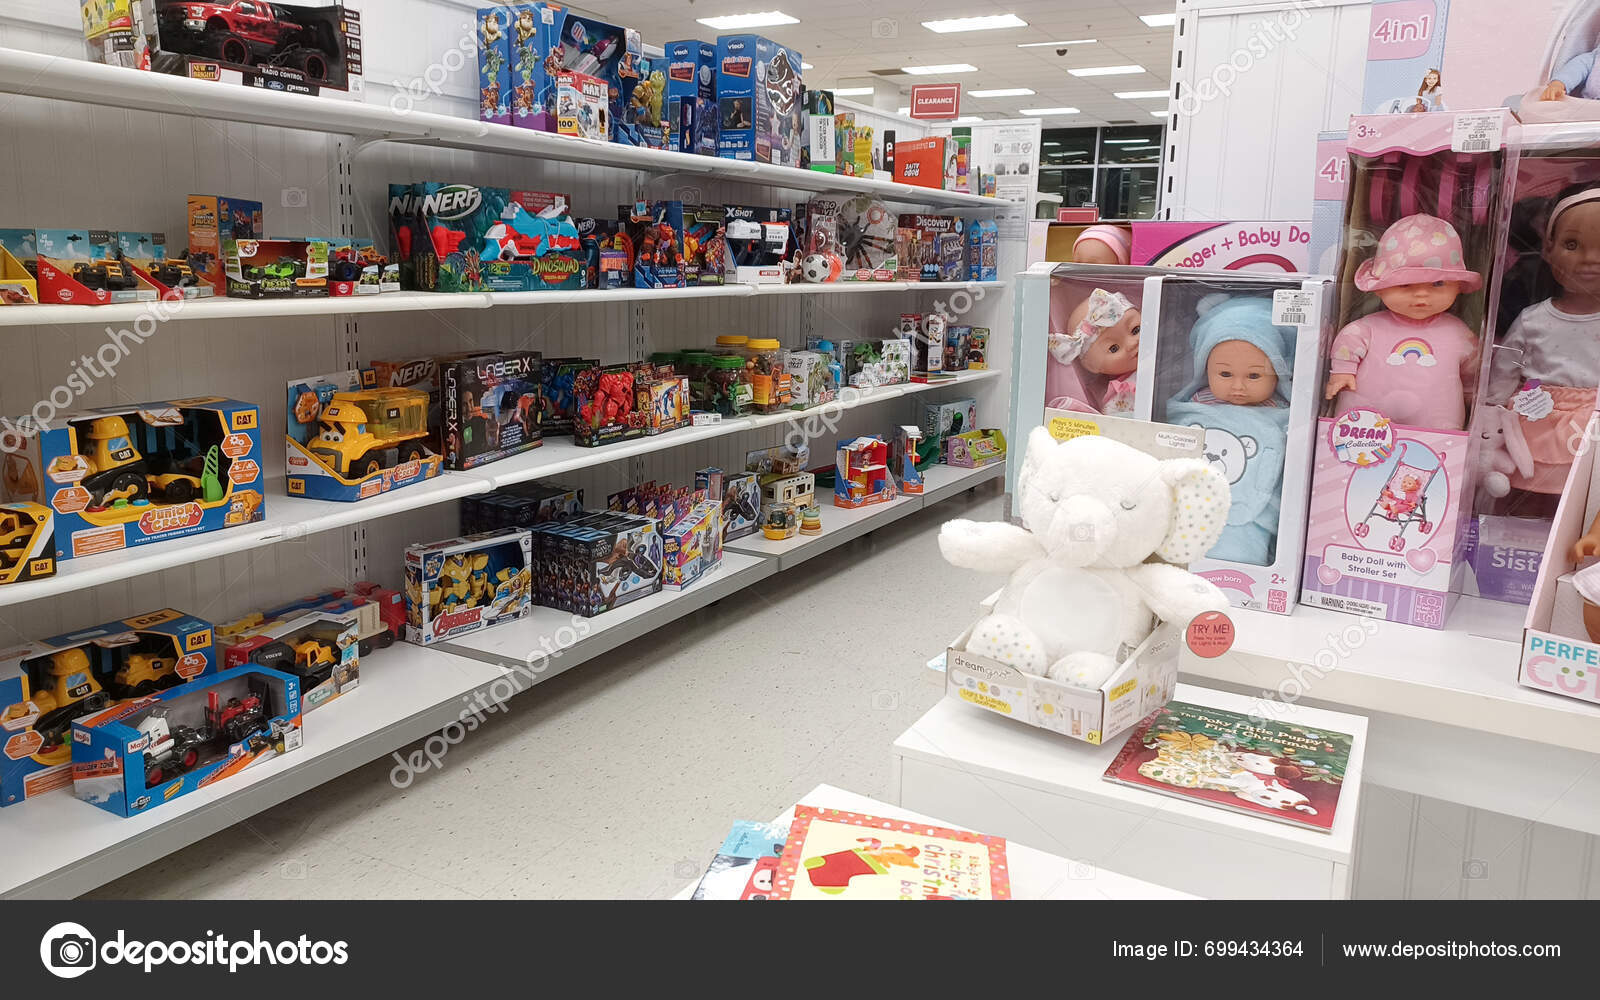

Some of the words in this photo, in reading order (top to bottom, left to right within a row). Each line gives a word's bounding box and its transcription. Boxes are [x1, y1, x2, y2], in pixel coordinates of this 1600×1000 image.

[1374, 17, 1430, 42] 4in1
[262, 67, 278, 76] RADIO
[280, 71, 303, 81] CONTROL
[1357, 125, 1376, 138] 3+
[423, 188, 479, 217] NERF
[578, 219, 595, 233] NERF
[916, 216, 951, 230] Discovery
[1239, 227, 1281, 248] Baby
[1289, 226, 1310, 243] Do
[533, 258, 579, 274] DINOSQUAD
[390, 360, 434, 387] NERF
[236, 415, 253, 426] CAT
[1052, 419, 1068, 428] Plays
[1074, 422, 1096, 430] Minutes
[1158, 434, 1197, 444] Multi-Colored
[1340, 424, 1387, 440] DREAM
[1345, 440, 1383, 450] Collection
[118, 449, 132, 459] CAT
[35, 562, 48, 572] CAT
[1342, 552, 1364, 565] Baby
[1367, 556, 1383, 566] Doll
[1387, 559, 1406, 570] with
[1492, 551, 1540, 572] Sist
[1271, 573, 1286, 584] 2+
[1348, 564, 1382, 578] Stroller
[1384, 569, 1397, 579] Set
[1192, 624, 1209, 634] TRY
[1213, 624, 1230, 634] ME!
[190, 634, 207, 646] CAT
[1531, 637, 1600, 665] PERFE
[76, 685, 89, 695] CAT
[1198, 715, 1232, 728] Poky
[1236, 722, 1274, 736] Little
[1278, 731, 1334, 748] Puppy's
[1204, 723, 1238, 734] First
[1242, 731, 1317, 751] Christmas
